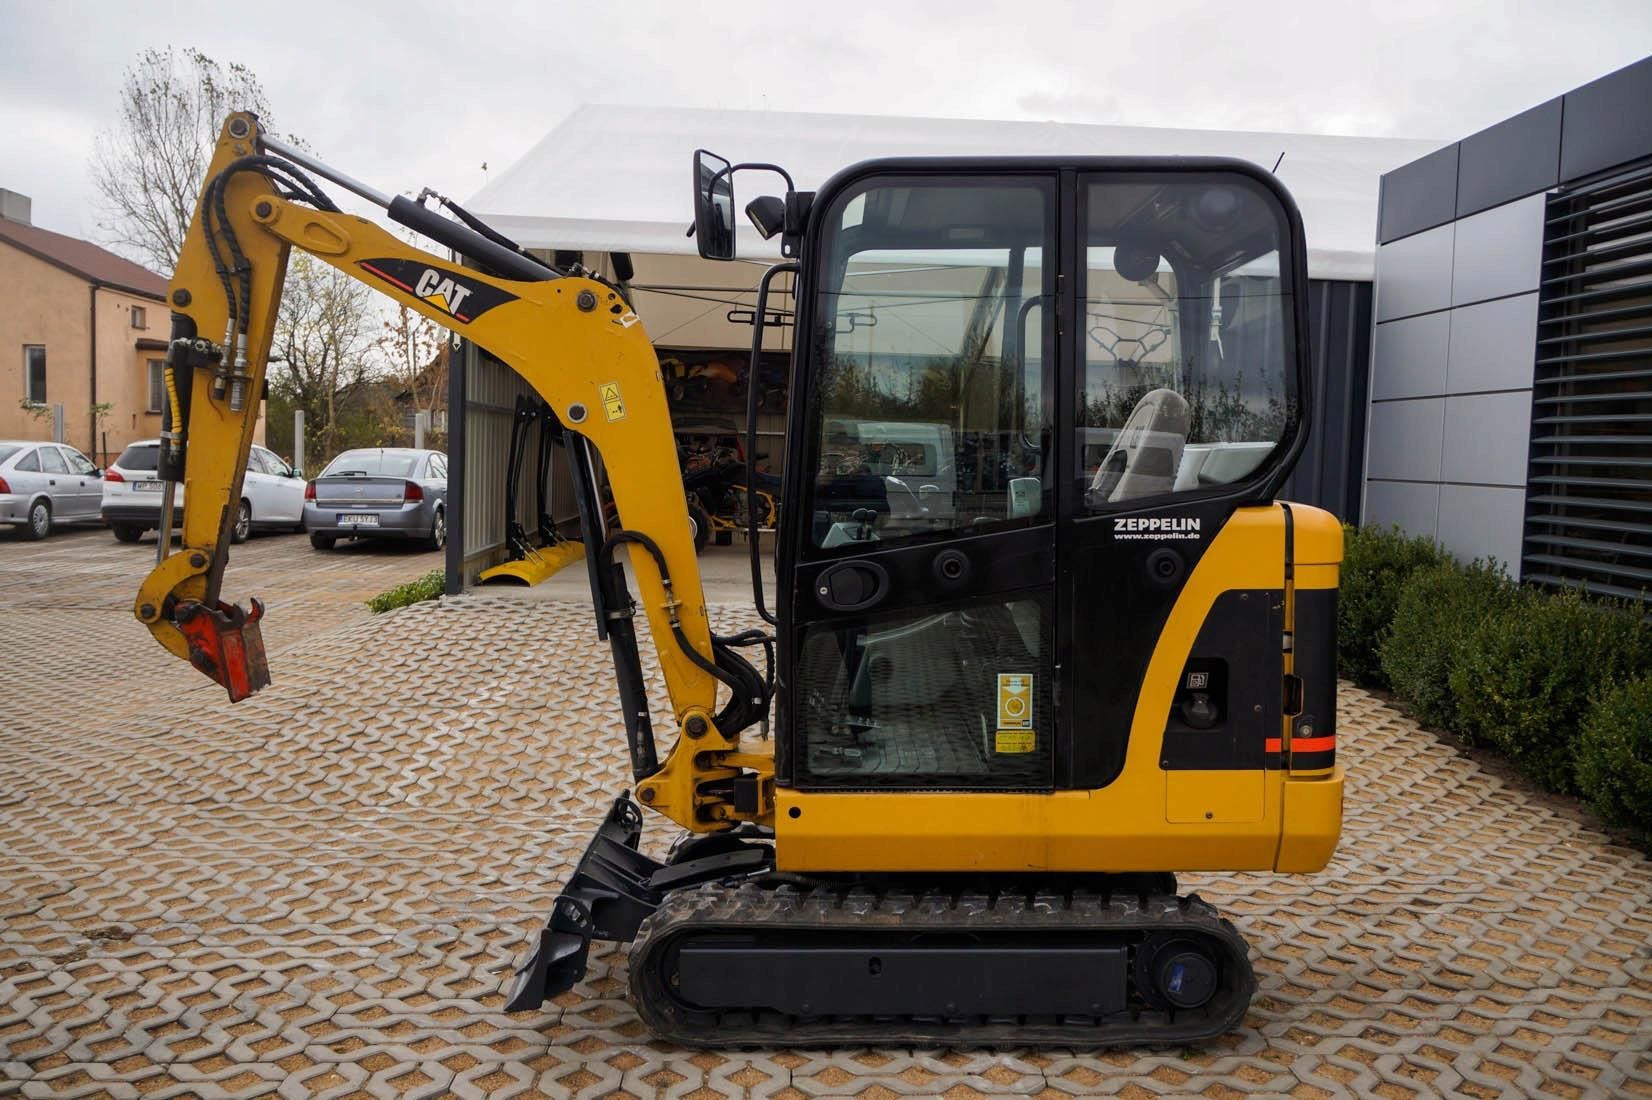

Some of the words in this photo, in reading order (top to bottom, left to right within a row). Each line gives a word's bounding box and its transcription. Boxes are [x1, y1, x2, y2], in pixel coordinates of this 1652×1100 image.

[415, 268, 472, 315] CAT
[1114, 518, 1201, 531] ZEPPELIN
[1114, 532, 1200, 541] www.zeppelin.de
